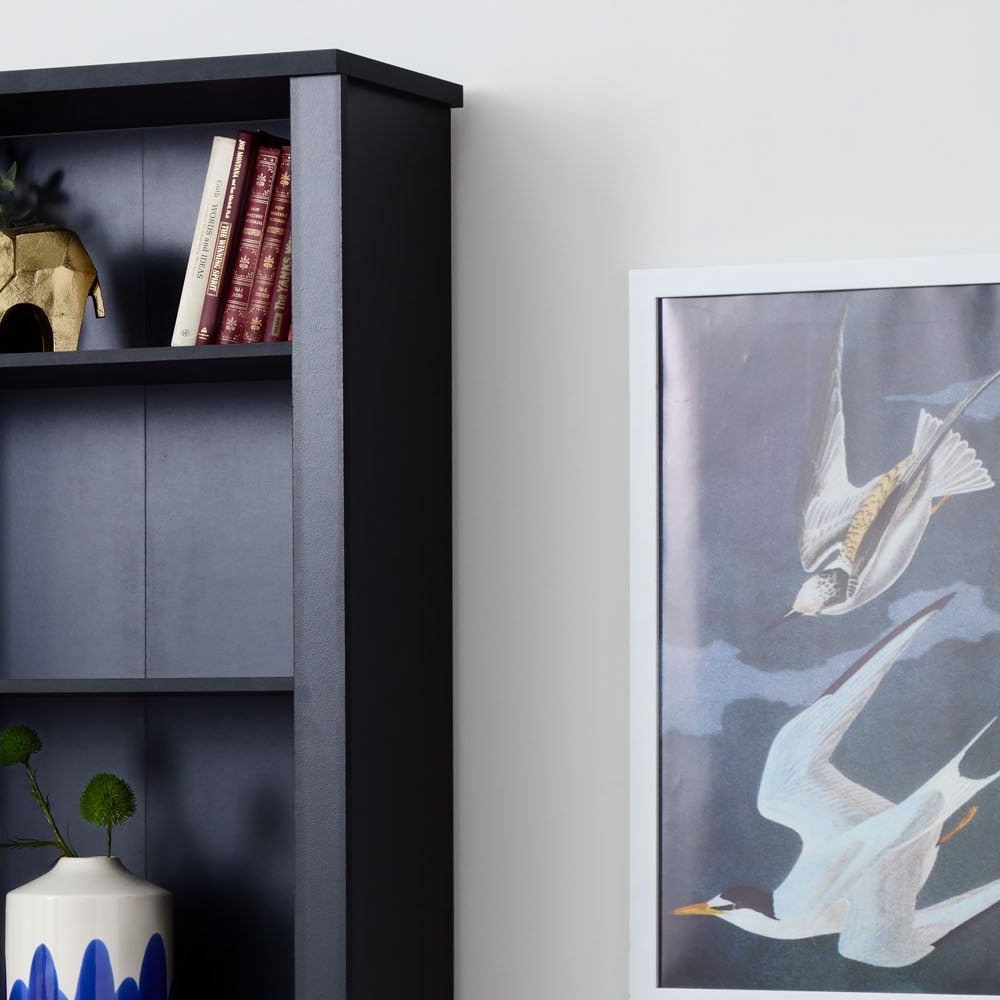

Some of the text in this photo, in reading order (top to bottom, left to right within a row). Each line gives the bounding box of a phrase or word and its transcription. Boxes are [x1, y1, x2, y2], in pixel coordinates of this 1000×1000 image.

[232, 151, 244, 178] MONTANA
[206, 204, 219, 236] WORDS
[196, 254, 207, 279] IDEAS
[209, 223, 229, 293] THE WINNING SPIRIT
[277, 256, 291, 292] YANKS
[274, 294, 287, 310] The
